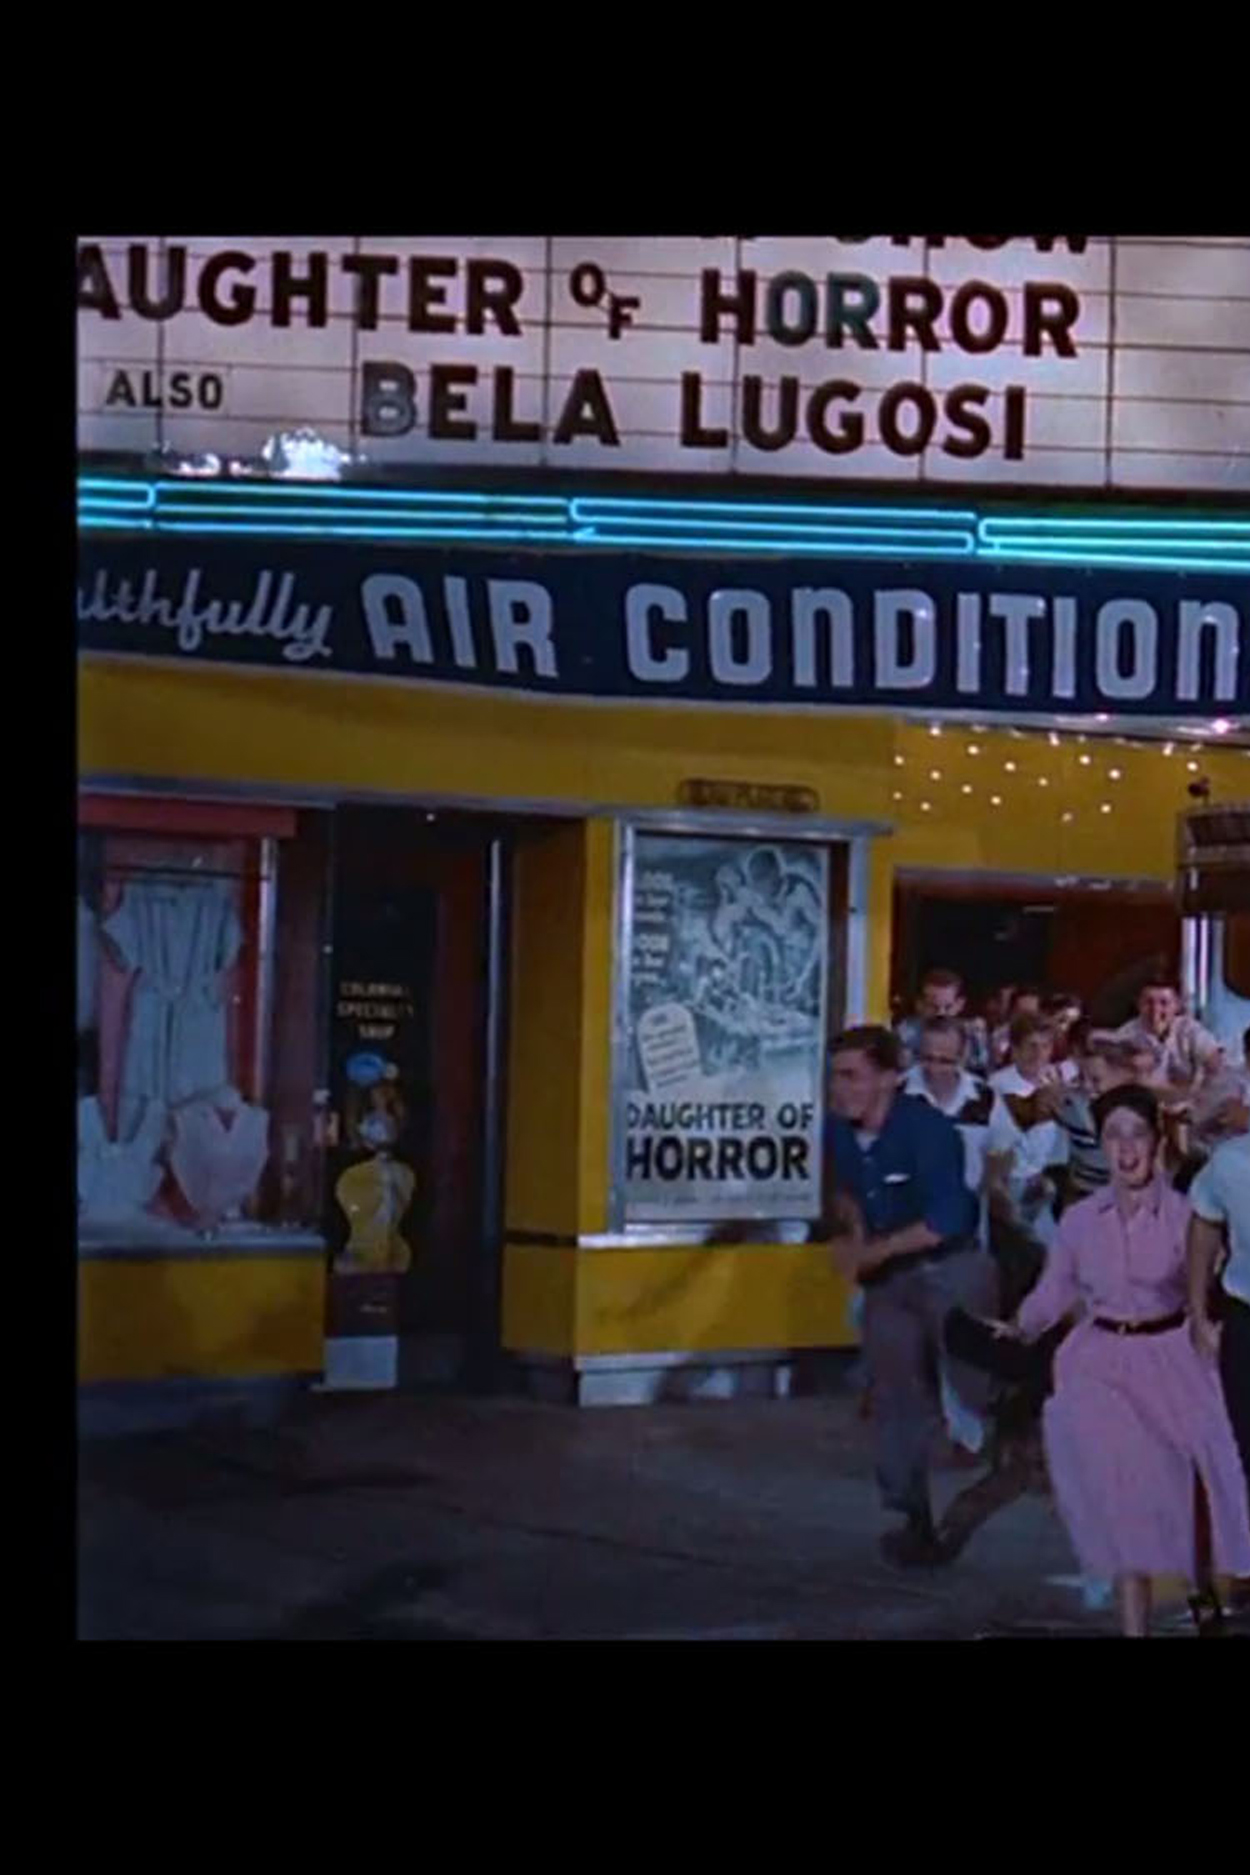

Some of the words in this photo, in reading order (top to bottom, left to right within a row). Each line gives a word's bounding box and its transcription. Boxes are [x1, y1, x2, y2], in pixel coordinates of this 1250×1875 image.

[699, 268, 1080, 358] HORROR
[104, 368, 225, 412] ALSO
[360, 359, 622, 447] BELA
[680, 371, 1026, 461] LUGOSI
[361, 573, 560, 679] AIR
[625, 1101, 766, 1132] DAUGHTER
[776, 1102, 814, 1131] OF
[625, 1134, 809, 1182] HORROR
